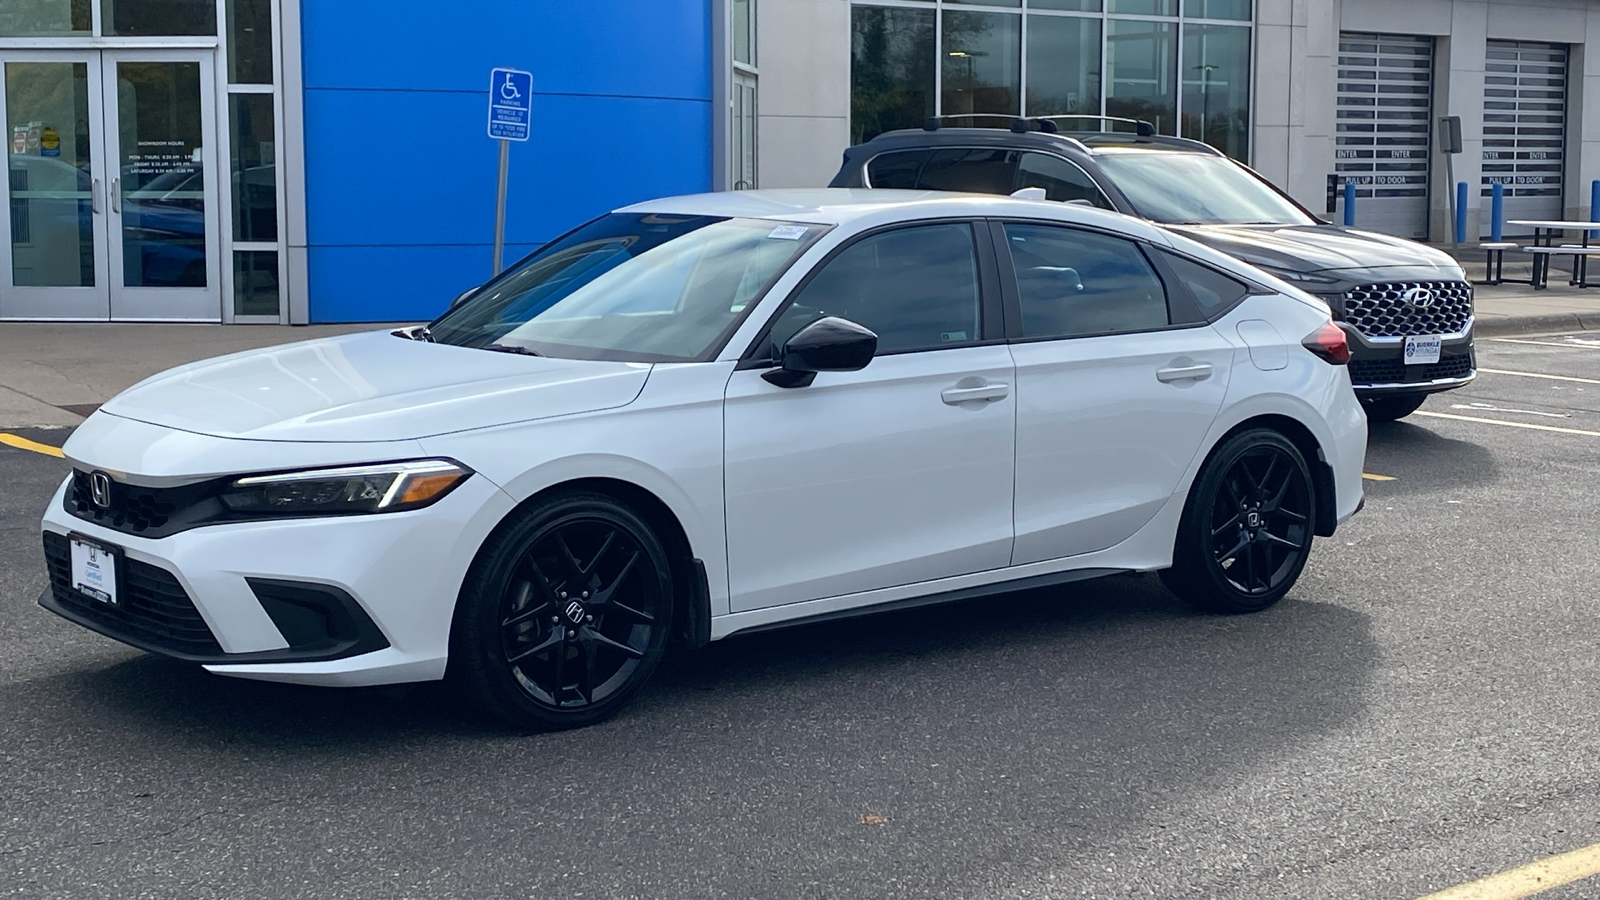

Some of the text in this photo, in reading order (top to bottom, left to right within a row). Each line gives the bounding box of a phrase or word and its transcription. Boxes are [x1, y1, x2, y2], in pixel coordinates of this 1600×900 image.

[1337, 150, 1358, 158] ENTER
[1391, 150, 1411, 158] ENTER
[1345, 176, 1361, 184] PULL
[1361, 176, 1371, 184] UP
[1503, 176, 1512, 184] UP
